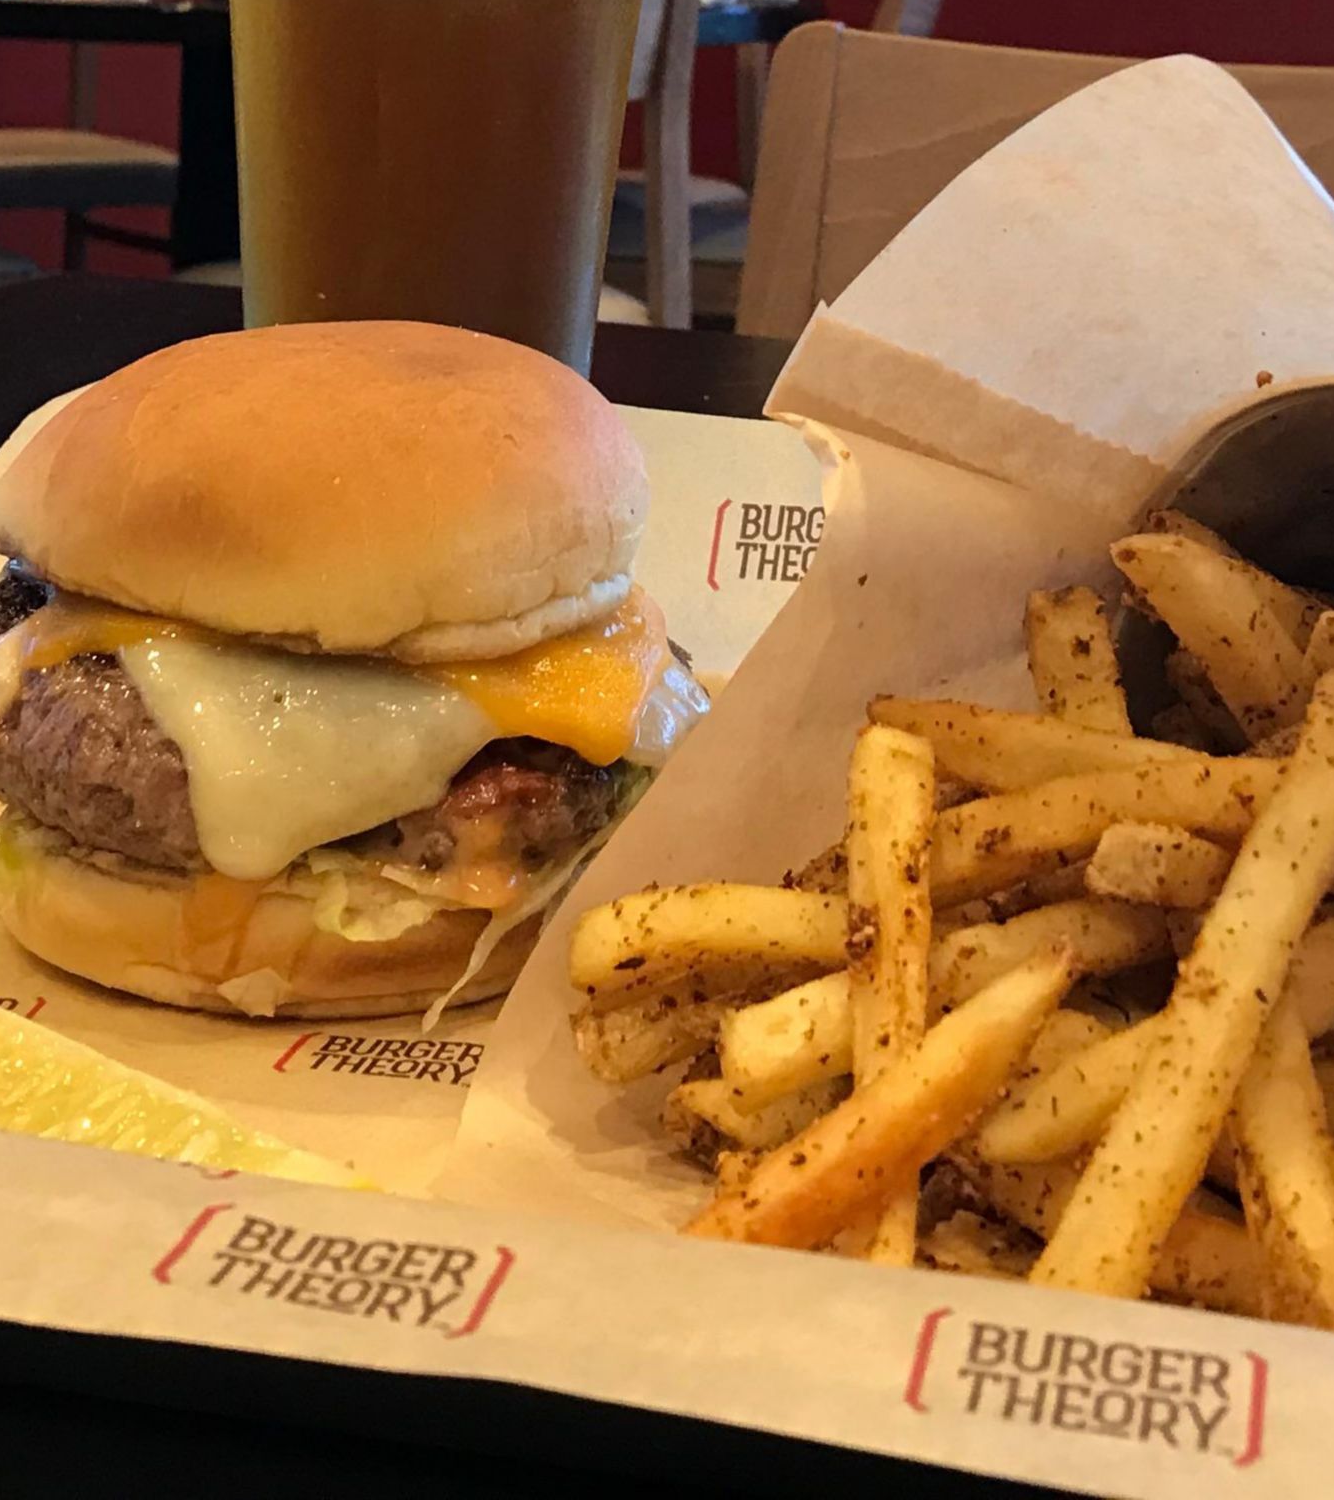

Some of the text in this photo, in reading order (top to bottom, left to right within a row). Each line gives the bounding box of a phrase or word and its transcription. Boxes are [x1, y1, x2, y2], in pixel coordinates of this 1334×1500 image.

[739, 503, 826, 544] BURG
[309, 1051, 477, 1086] THEORY
[319, 1035, 485, 1065] BURGER
[225, 1215, 480, 1288] BURGER
[207, 1250, 461, 1328] THEORY
[966, 1320, 1232, 1401] BURGER
[957, 1367, 1233, 1454] THEORY
